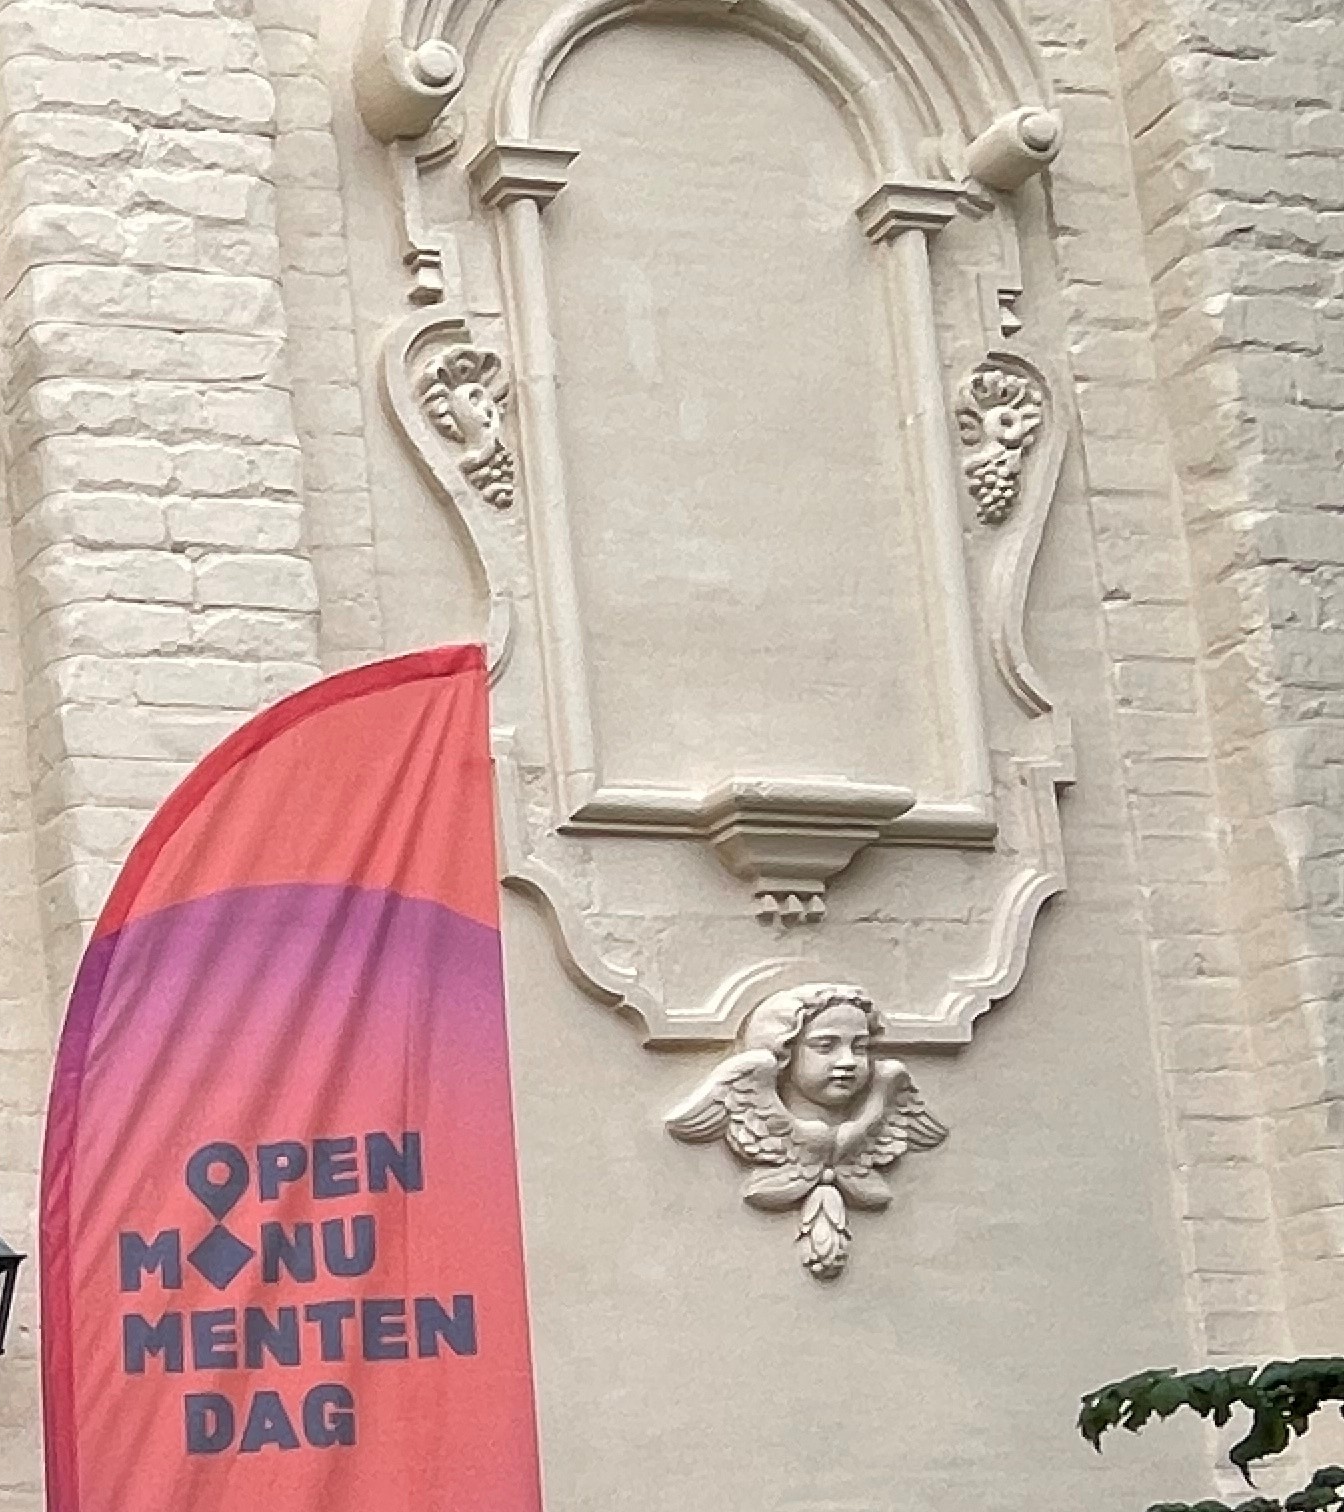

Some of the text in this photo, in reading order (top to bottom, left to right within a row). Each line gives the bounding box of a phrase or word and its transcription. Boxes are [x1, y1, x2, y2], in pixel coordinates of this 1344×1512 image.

[186, 1131, 424, 1222] OPEN
[123, 1294, 477, 1375] MENTEN
[184, 1383, 356, 1456] DAG
